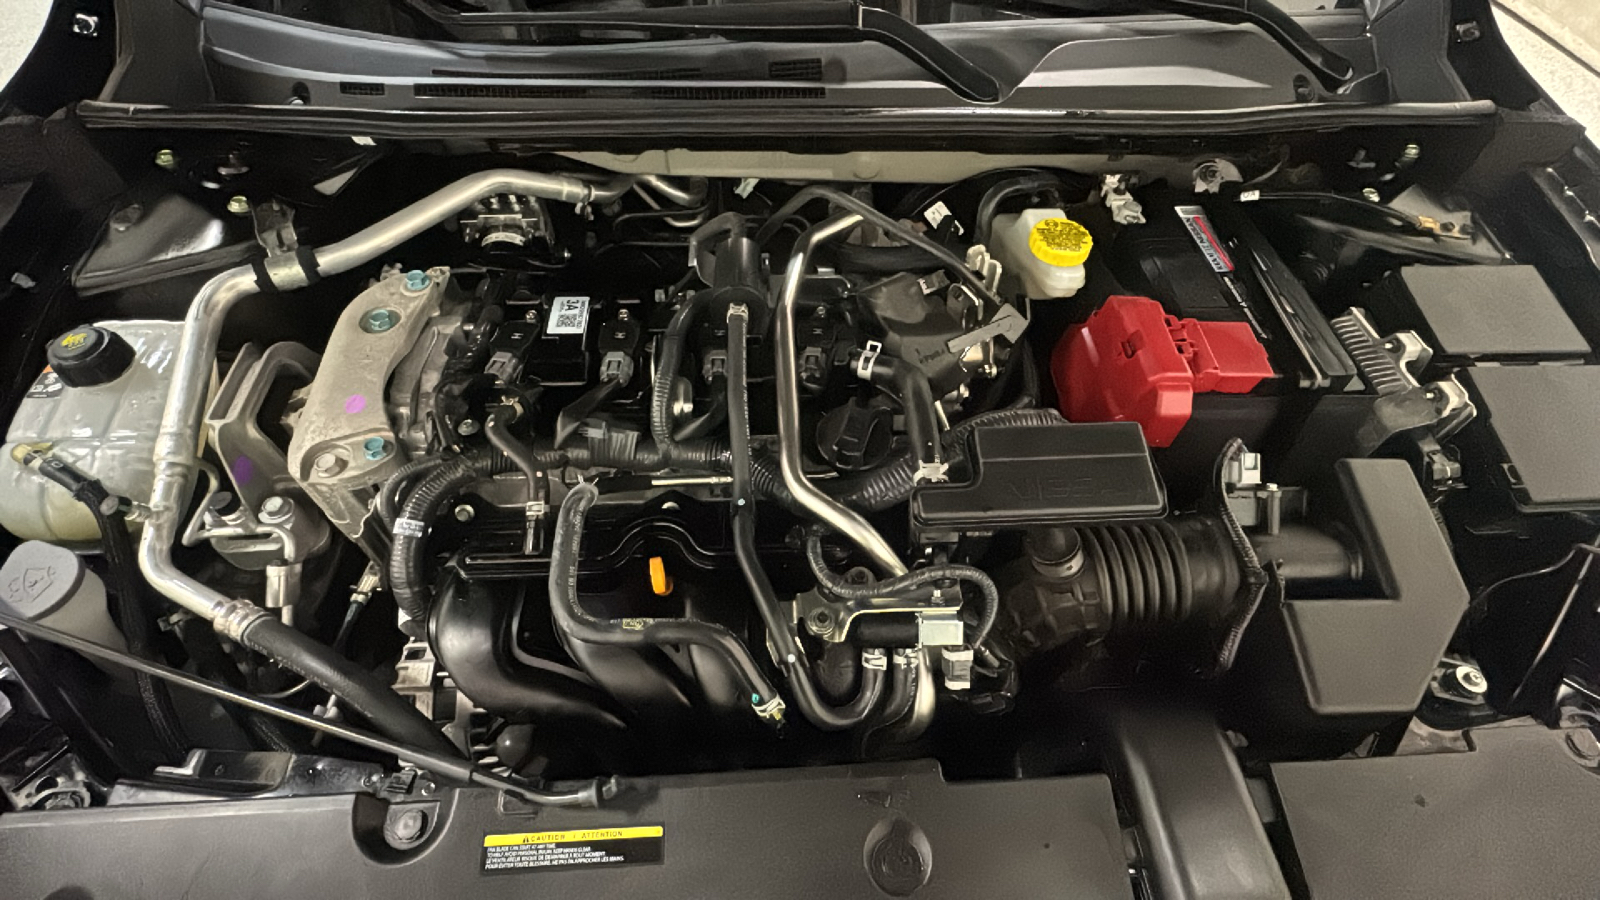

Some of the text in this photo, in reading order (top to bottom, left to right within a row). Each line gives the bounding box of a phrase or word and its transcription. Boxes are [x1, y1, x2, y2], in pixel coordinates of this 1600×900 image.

[565, 299, 579, 311] 3A
[1002, 475, 1149, 500] NISS
[531, 834, 565, 842] CAUTION
[581, 831, 623, 839] ATTENTION
